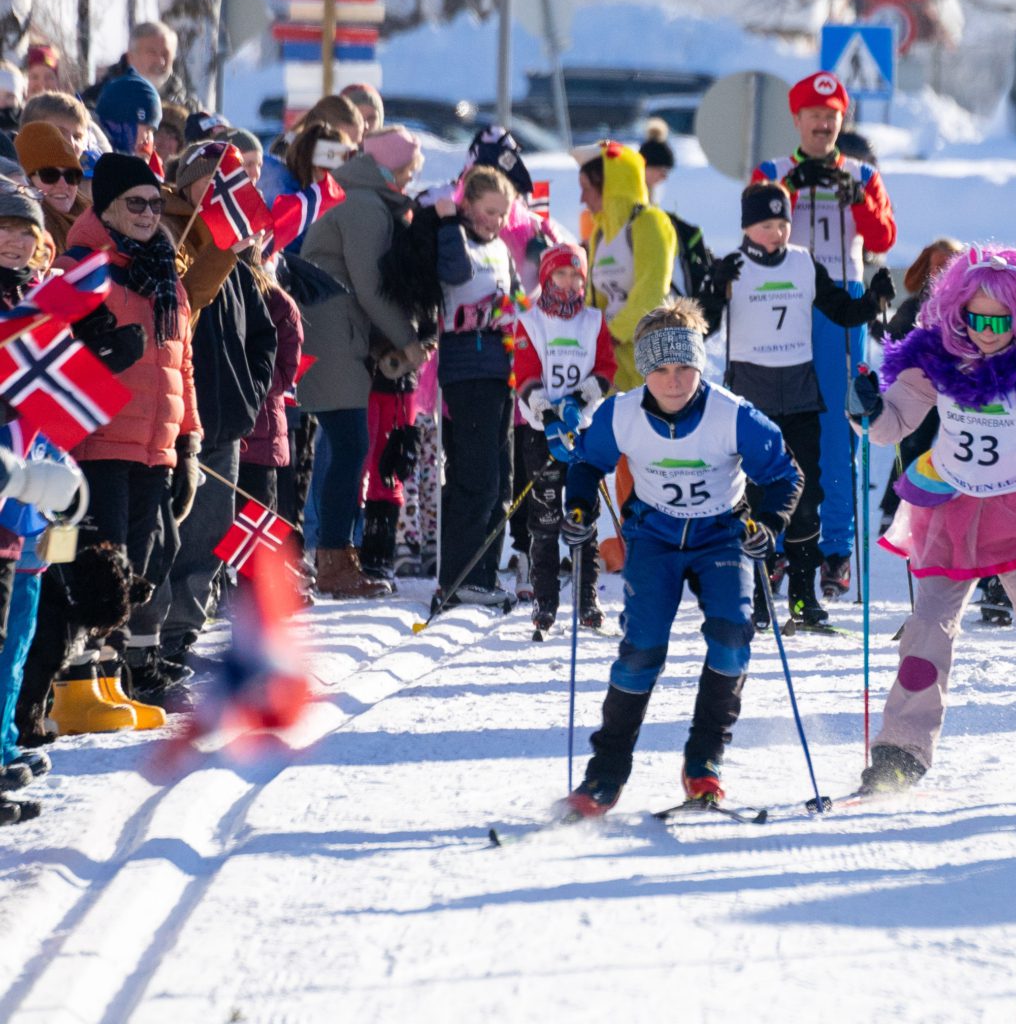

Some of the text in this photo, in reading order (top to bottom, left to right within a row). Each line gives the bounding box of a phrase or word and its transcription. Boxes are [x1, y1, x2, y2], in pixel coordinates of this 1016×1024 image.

[818, 217, 830, 242] 1
[772, 306, 787, 330] 7
[551, 364, 581, 389] 59
[946, 410, 1016, 428] SKUE SPAREBANK
[953, 430, 1000, 467] 33
[662, 479, 711, 508] 25
